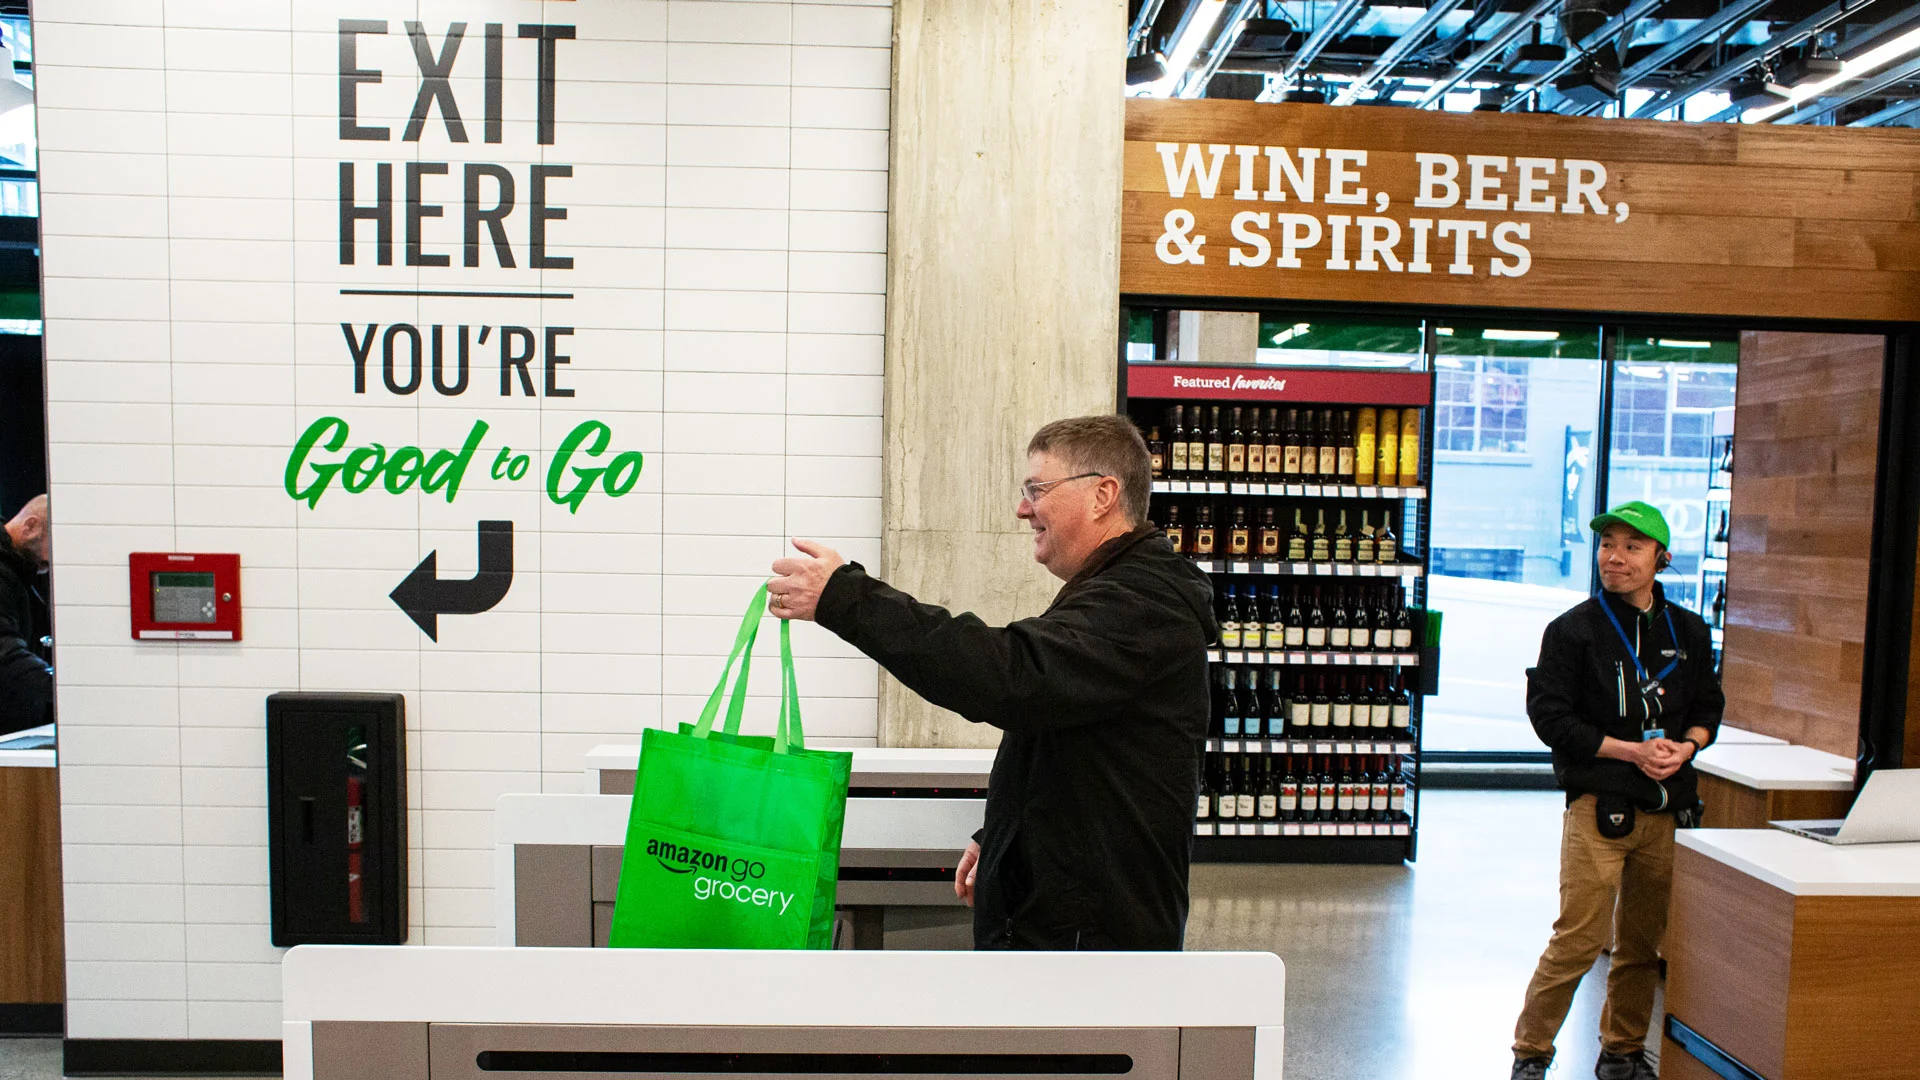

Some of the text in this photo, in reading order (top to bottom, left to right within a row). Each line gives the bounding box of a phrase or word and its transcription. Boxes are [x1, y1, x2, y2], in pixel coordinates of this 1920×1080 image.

[338, 19, 577, 146] EXIT
[339, 161, 574, 270] HERE
[1155, 141, 1630, 224] WINE, BEER,
[1155, 208, 1532, 278] & SPIRITS
[340, 322, 576, 398] YOU'RE
[1173, 374, 1287, 391] Featured favorites
[284, 415, 644, 515] Good to Go
[646, 838, 766, 882] amazon go
[693, 876, 795, 916] grocery
